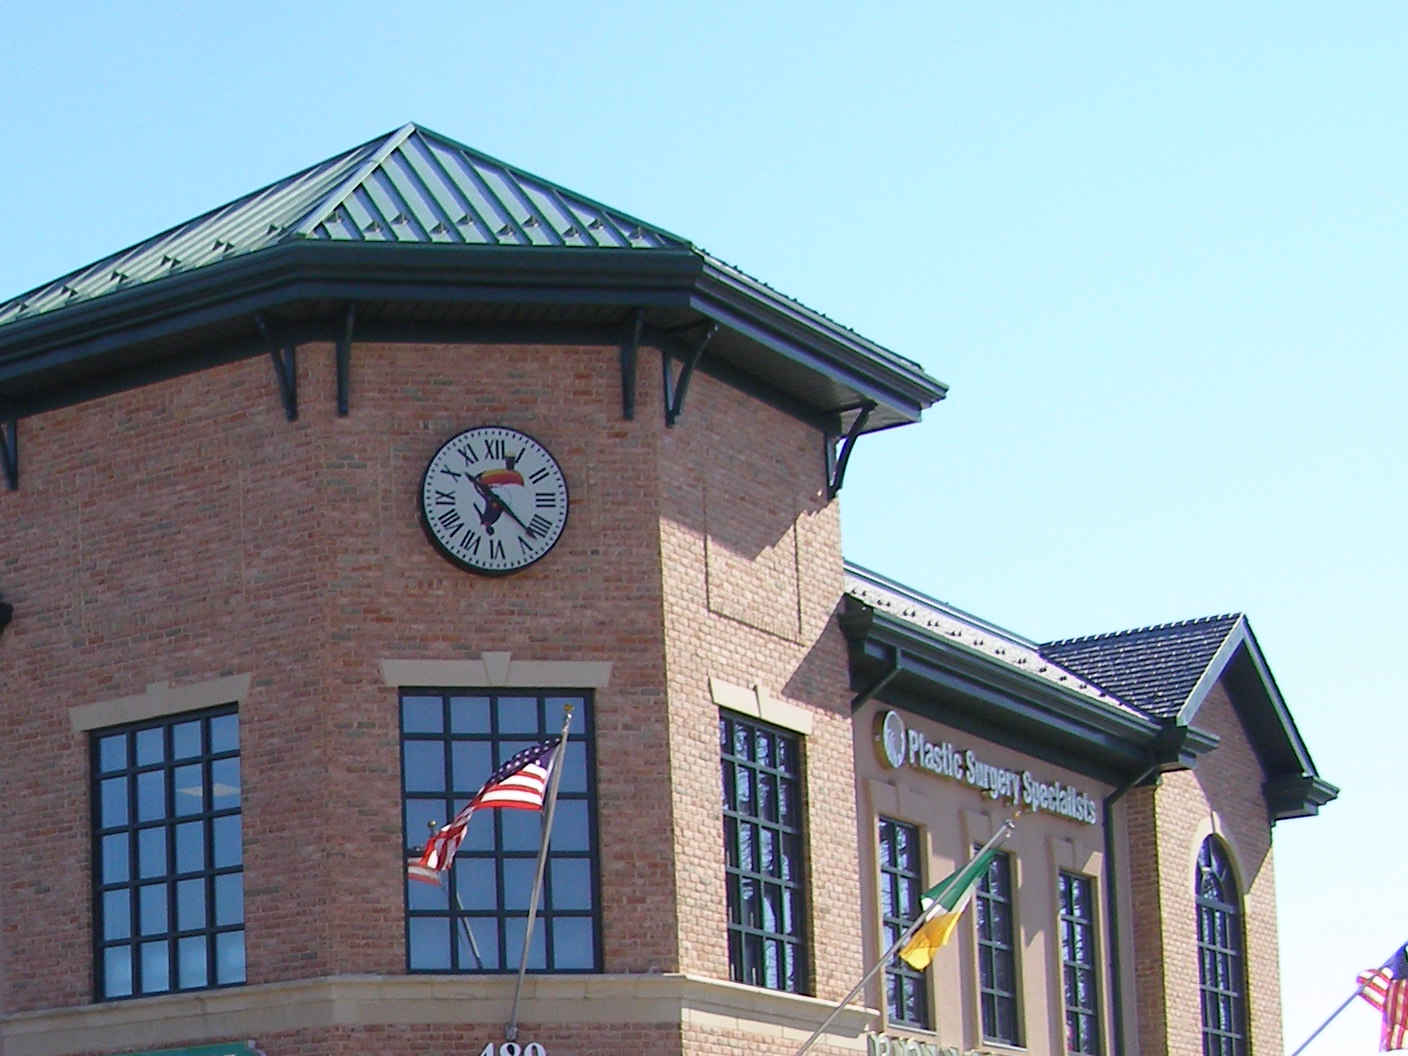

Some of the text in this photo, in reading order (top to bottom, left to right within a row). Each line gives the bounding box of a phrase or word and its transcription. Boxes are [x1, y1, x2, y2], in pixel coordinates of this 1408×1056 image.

[908, 729, 1097, 825] Plastic Surgery Specialists
